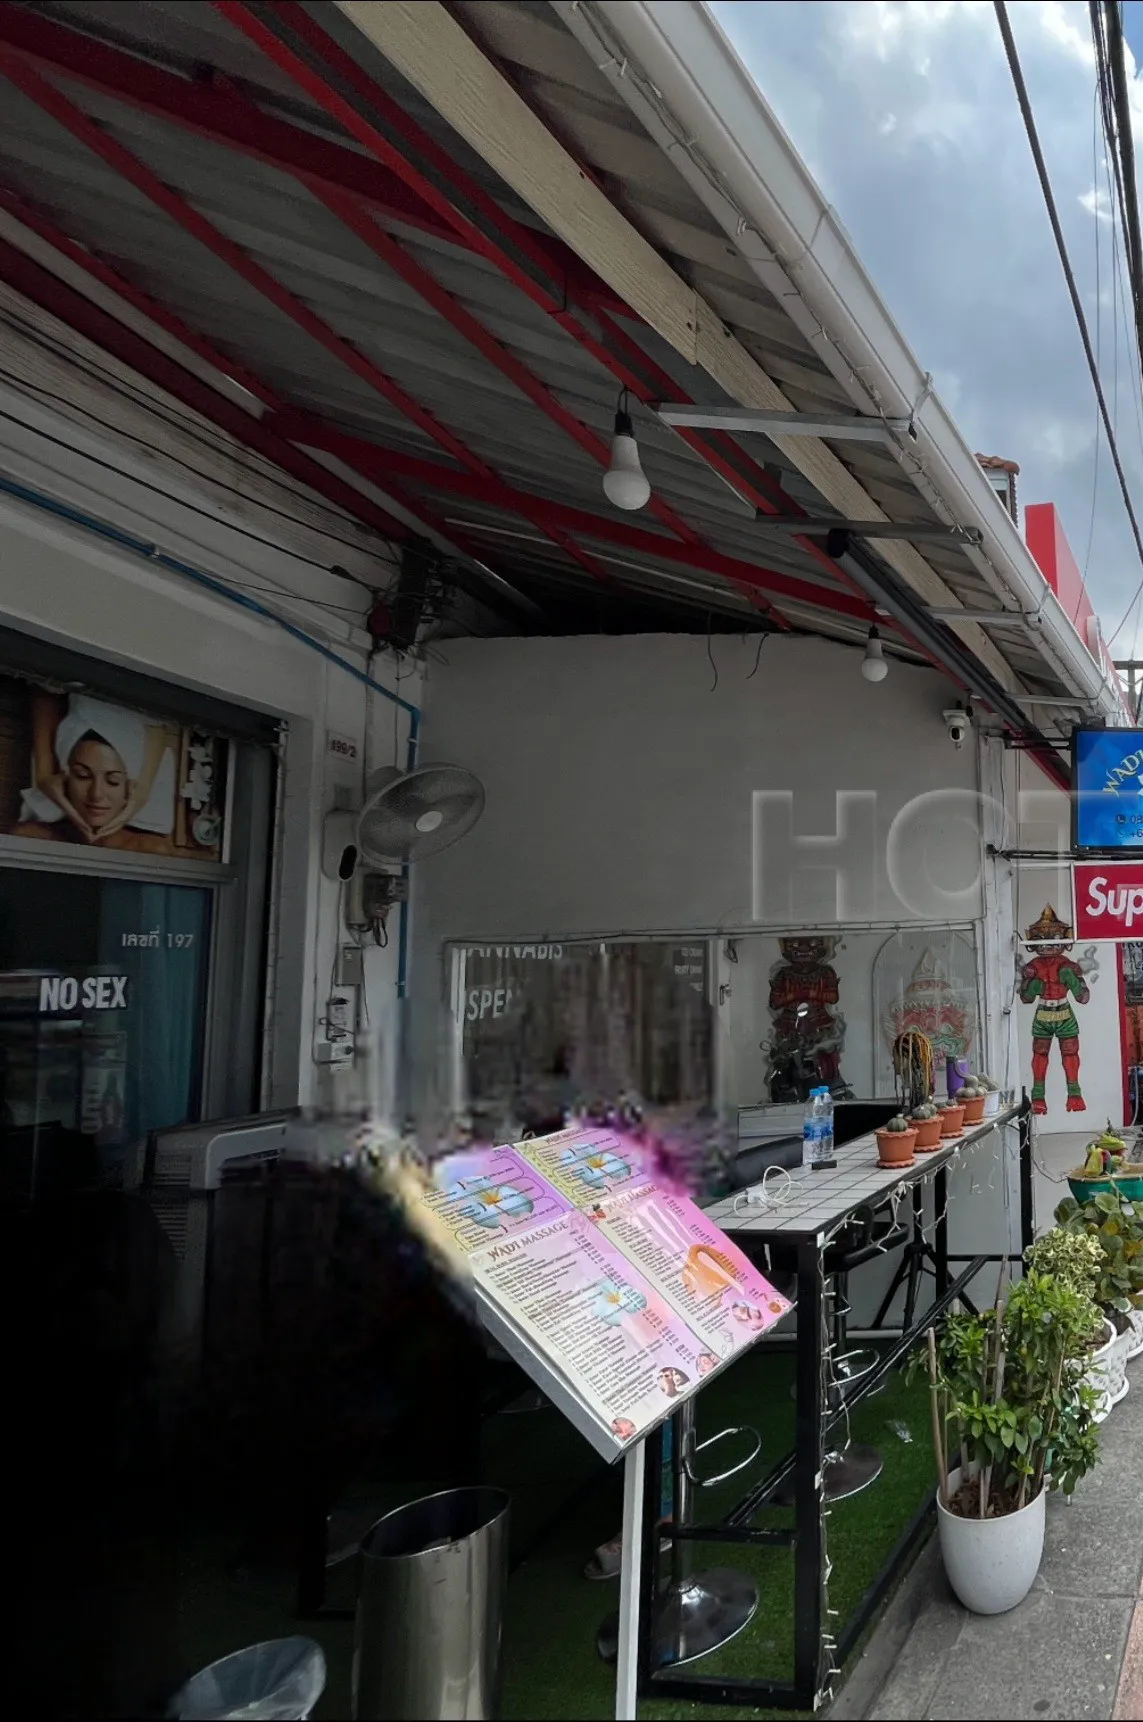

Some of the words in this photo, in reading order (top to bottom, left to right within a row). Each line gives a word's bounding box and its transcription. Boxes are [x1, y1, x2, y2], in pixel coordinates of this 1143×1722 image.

[121, 926, 160, 948] เลขที่
[167, 933, 194, 948] 197
[39, 977, 79, 1012] NO
[81, 976, 128, 1009] SEX
[487, 1240, 521, 1261] WADI
[519, 1221, 569, 1247] MASSAGE
